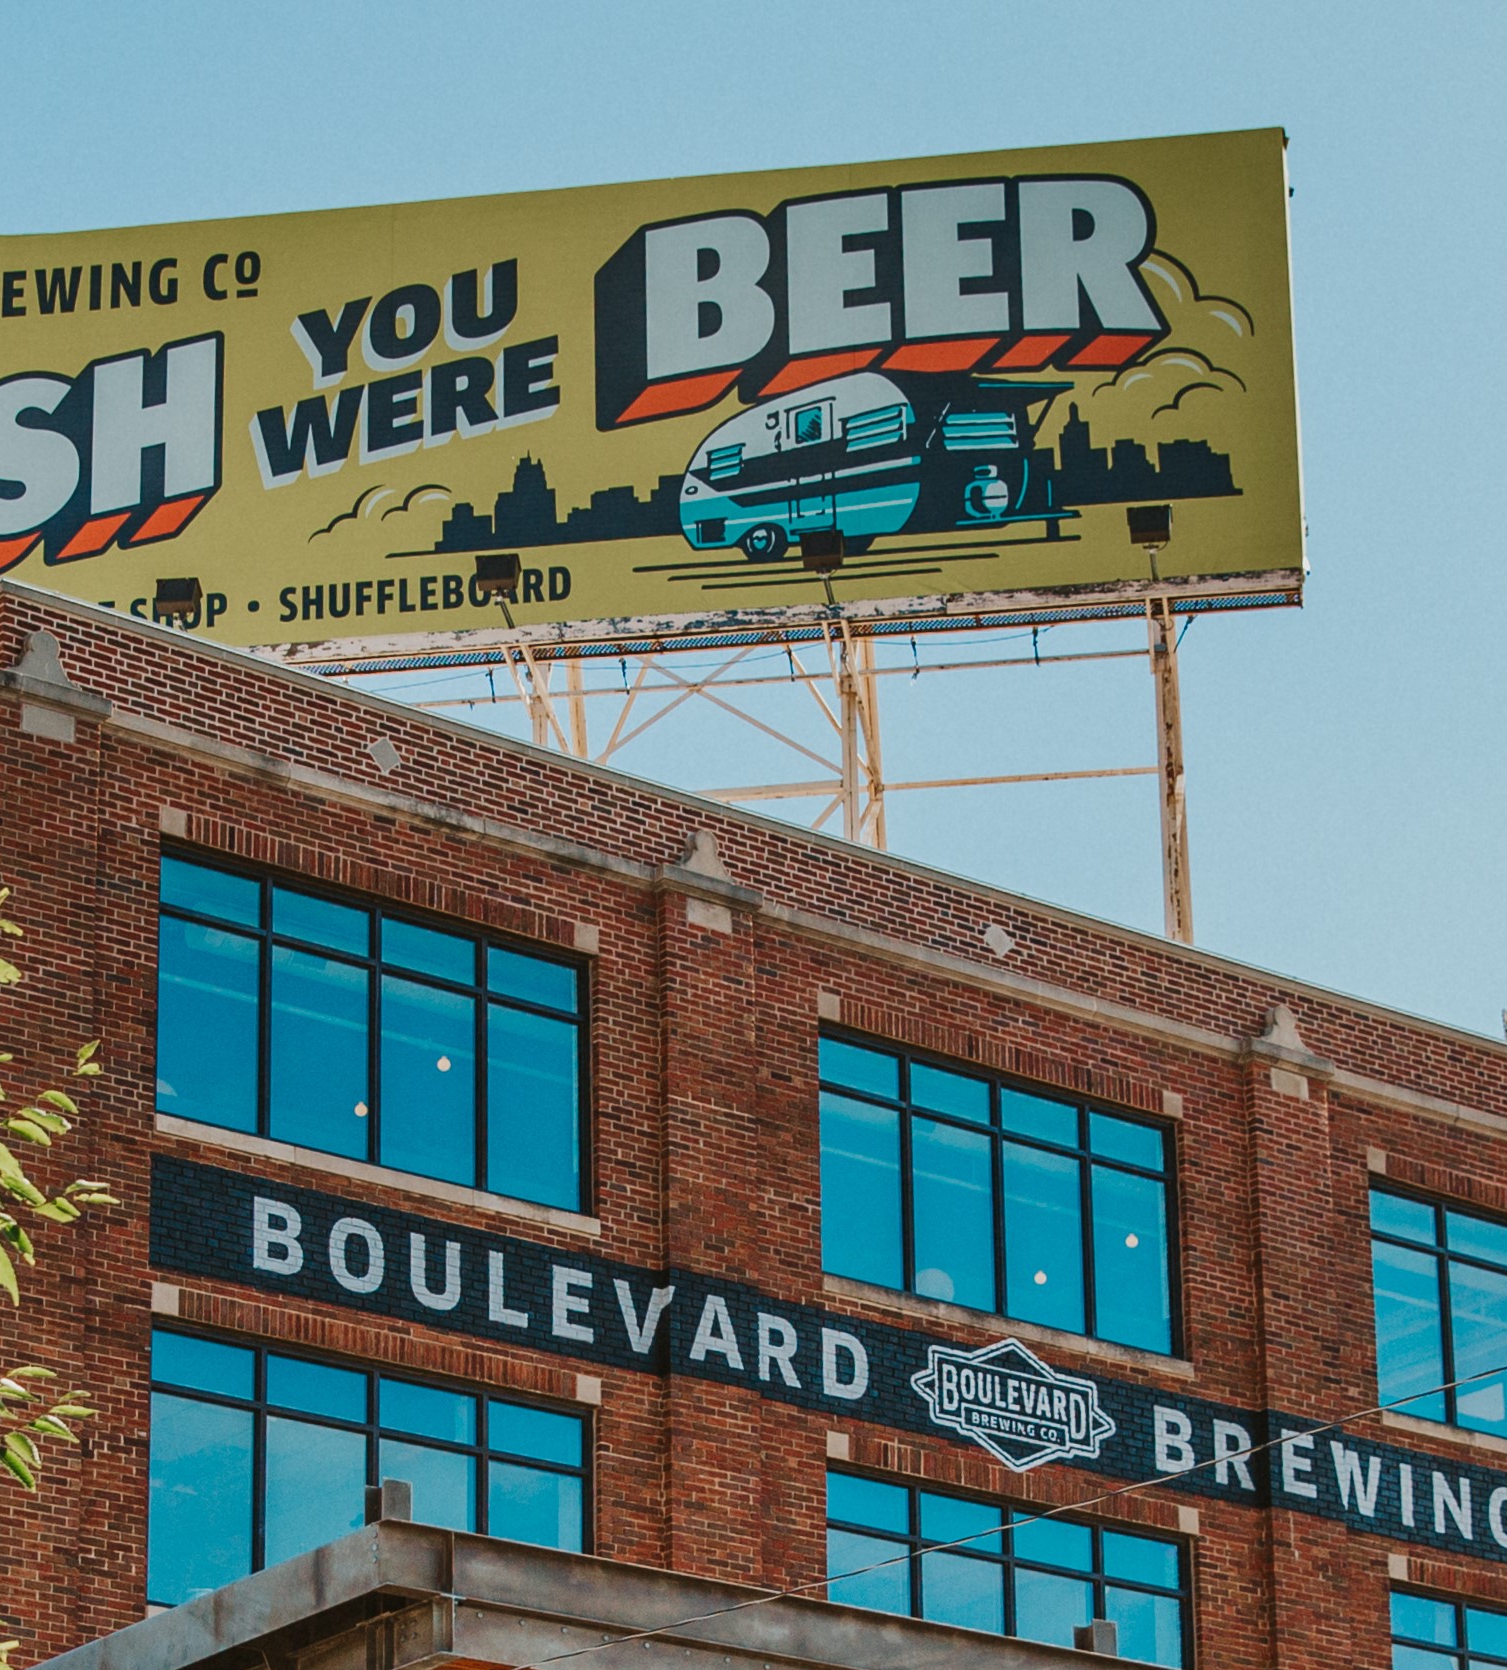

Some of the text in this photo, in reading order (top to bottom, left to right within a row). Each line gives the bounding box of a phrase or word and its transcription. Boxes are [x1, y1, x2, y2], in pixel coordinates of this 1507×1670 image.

[290, 258, 518, 389] YOU
[644, 177, 1165, 383] BEER
[249, 335, 561, 488] WERE
[252, 1195, 870, 1400] BOULEVARD
[942, 1363, 1087, 1440] BOULEVARD
[971, 1411, 1036, 1437] BREWING
